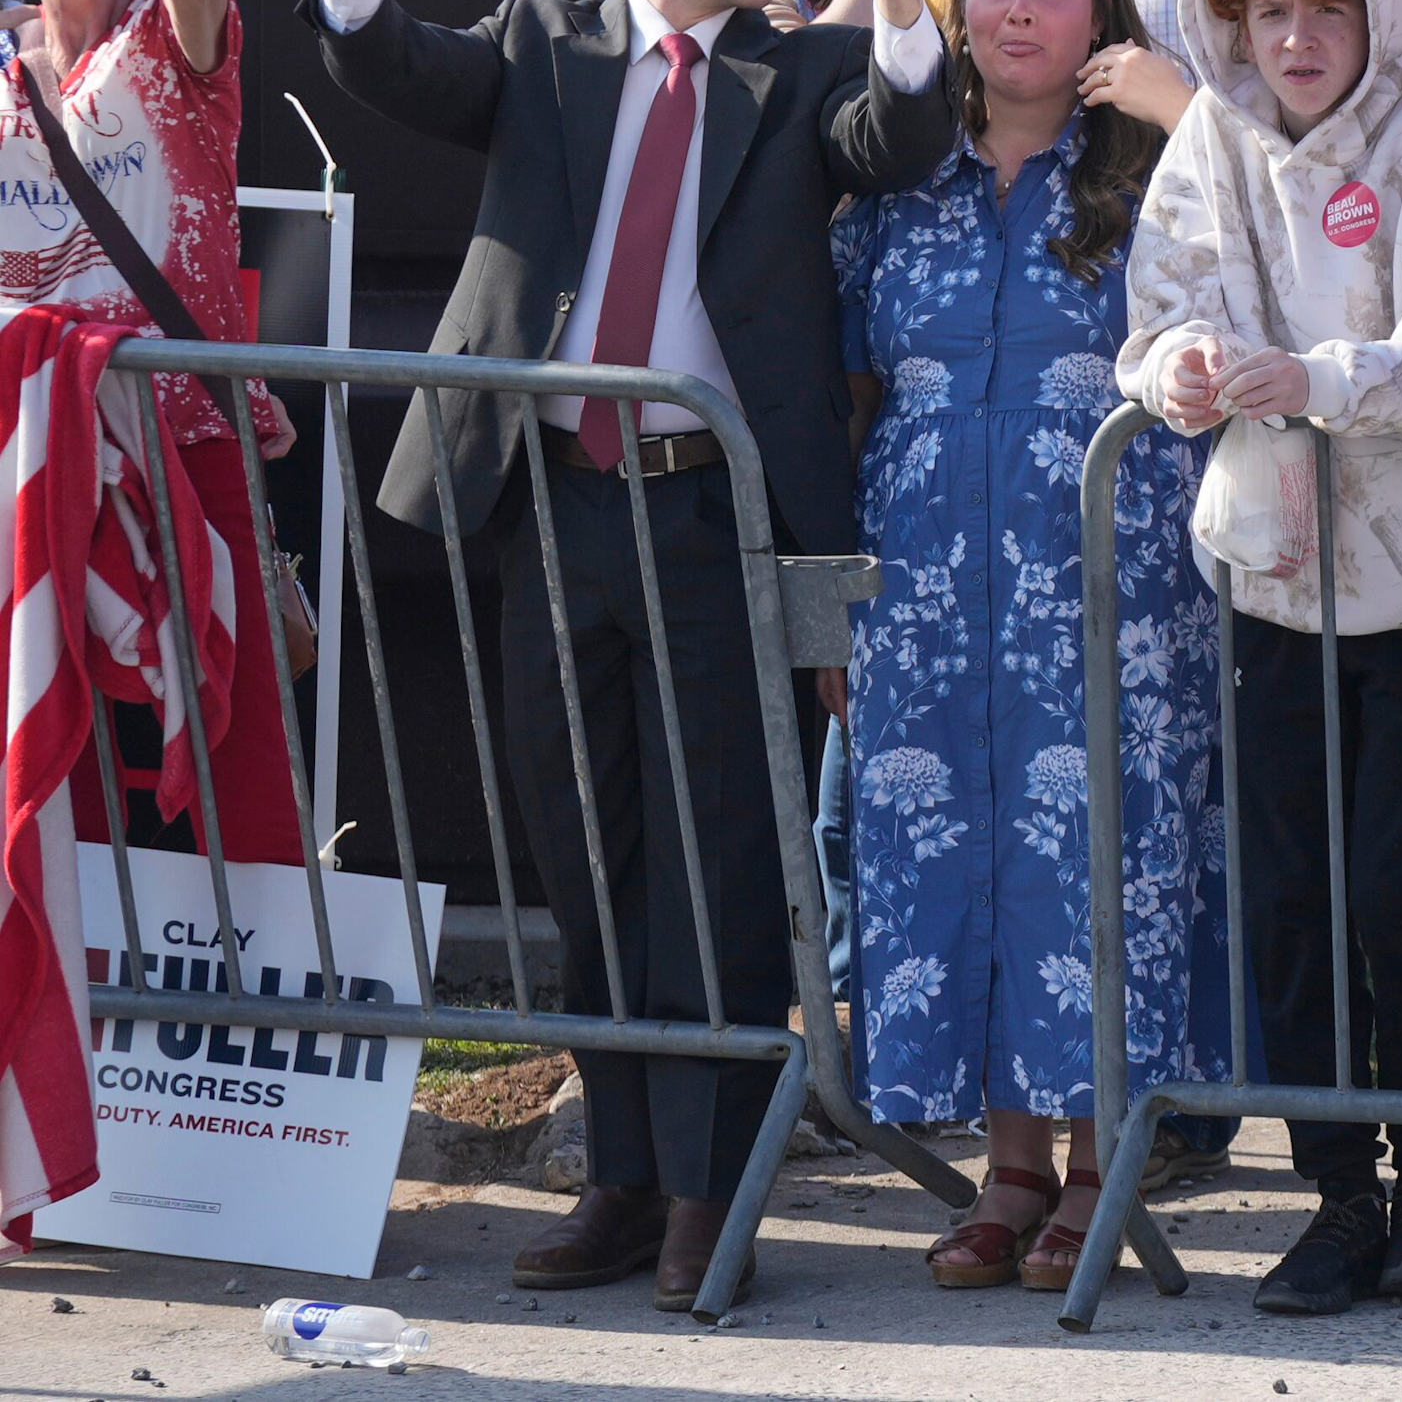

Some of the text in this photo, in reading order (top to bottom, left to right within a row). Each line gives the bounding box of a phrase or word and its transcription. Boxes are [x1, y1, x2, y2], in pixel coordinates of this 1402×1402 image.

[1327, 195, 1356, 214] BEAU
[1327, 202, 1373, 226] BROWN
[1341, 217, 1376, 232] CONGRESS
[112, 950, 394, 1082] FULLER
[97, 1065, 286, 1108] CONGRESS
[96, 1104, 351, 1147] DUTY. AMERICA FIRST.
